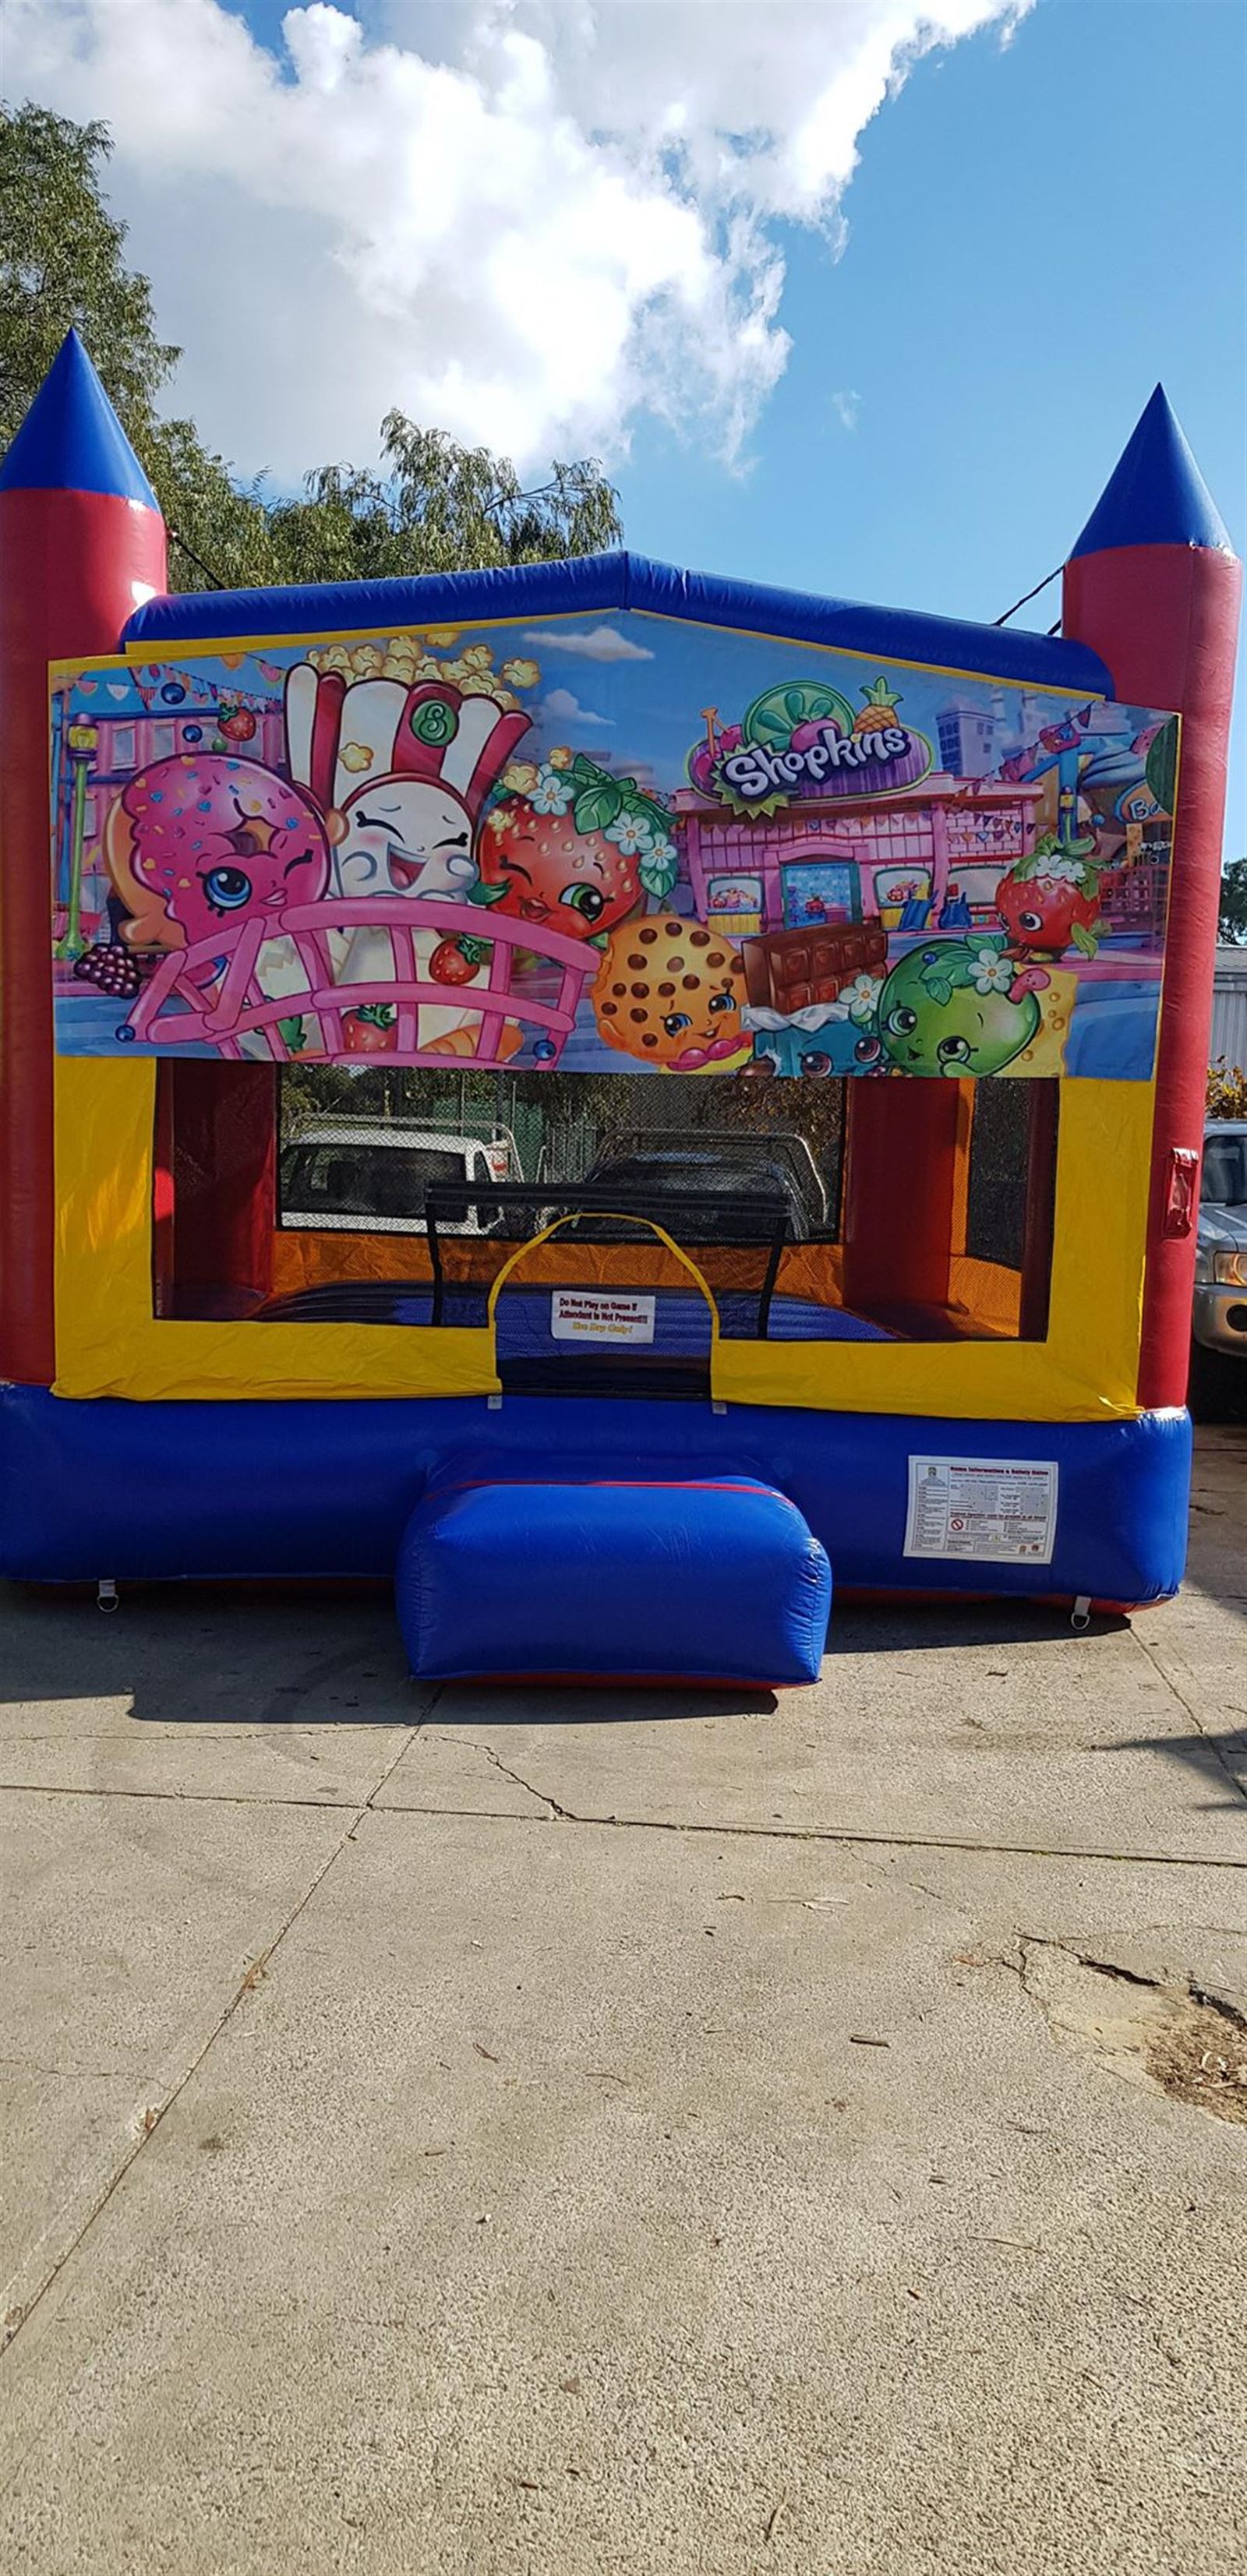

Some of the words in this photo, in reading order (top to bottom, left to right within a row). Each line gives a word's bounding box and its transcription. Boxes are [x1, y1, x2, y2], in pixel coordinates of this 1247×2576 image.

[723, 726, 910, 797] Shopkins
[571, 1298, 582, 1307] Not
[585, 1300, 599, 1311] Play
[610, 1302, 631, 1311] Game
[602, 1313, 613, 1322] Not
